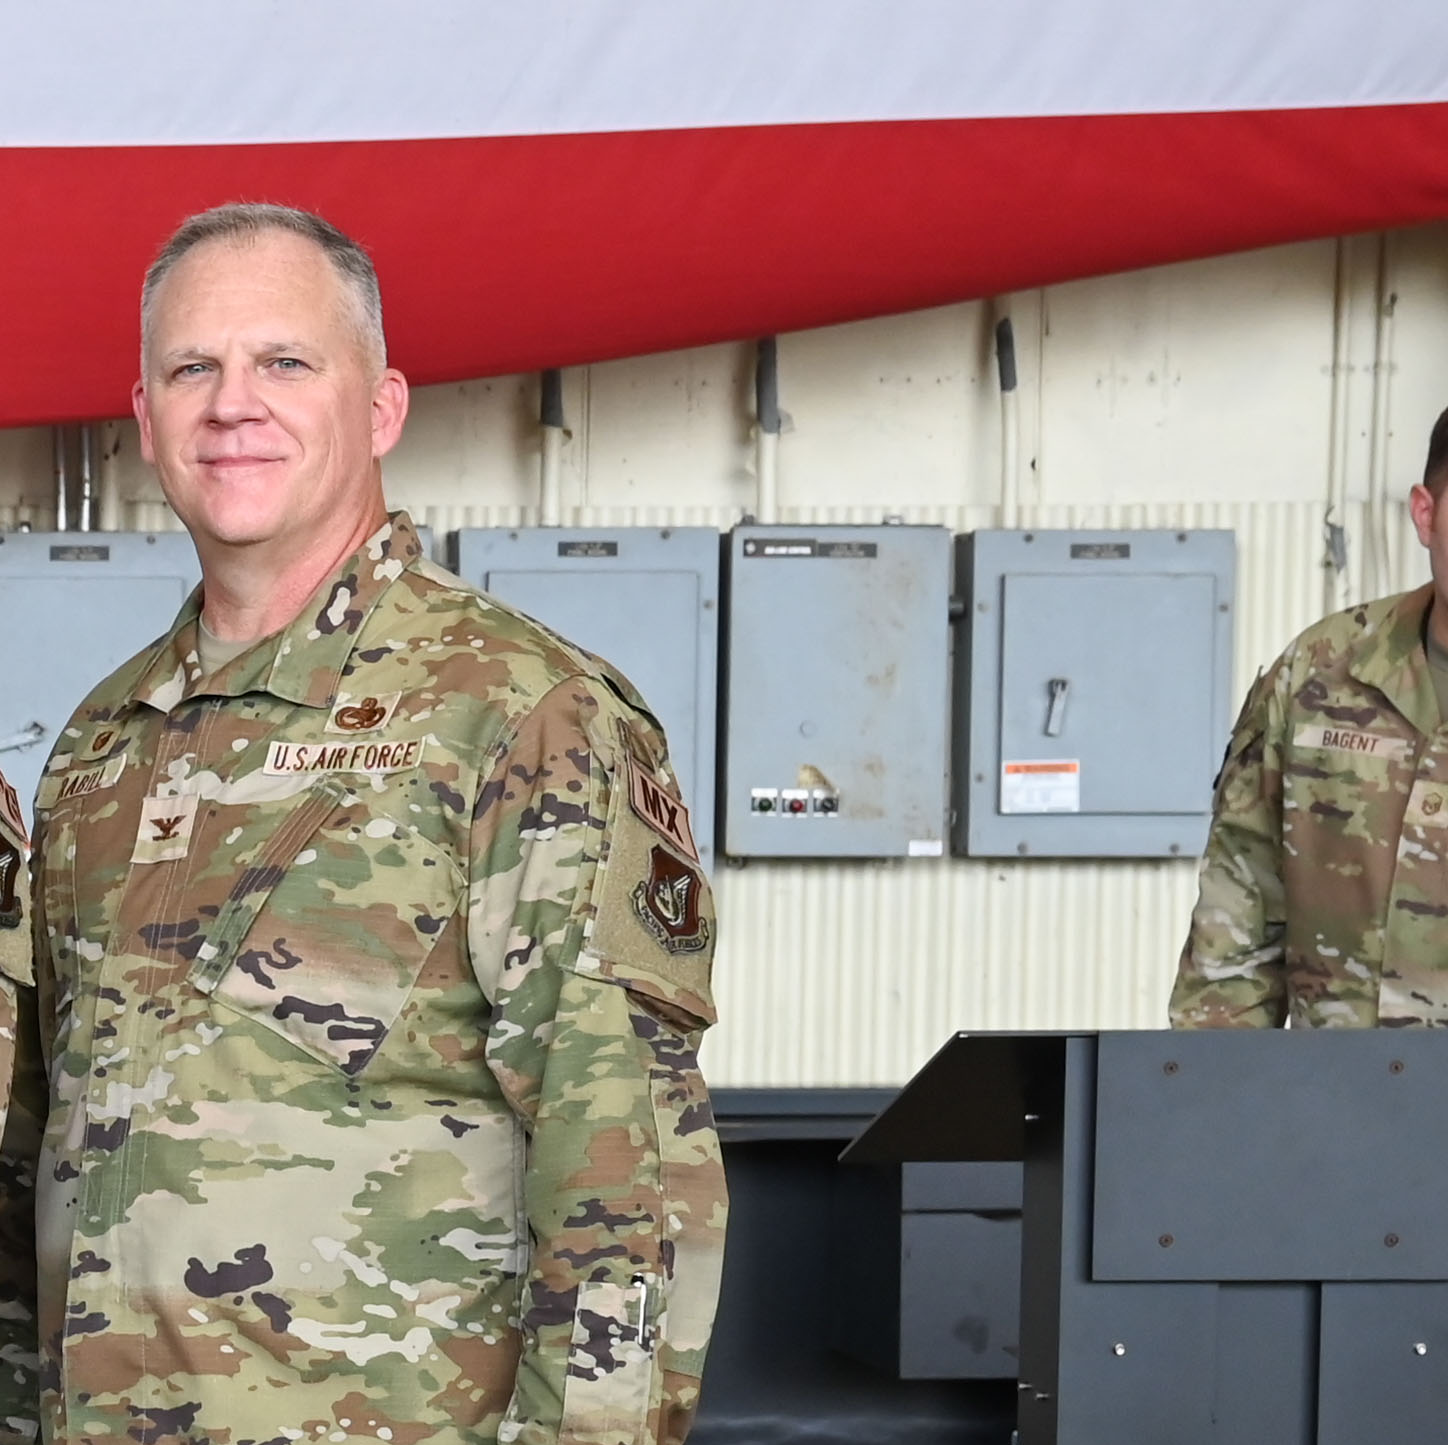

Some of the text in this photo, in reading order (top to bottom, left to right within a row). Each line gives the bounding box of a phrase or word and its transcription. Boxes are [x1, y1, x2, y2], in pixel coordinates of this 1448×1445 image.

[1322, 730, 1380, 753] BAGENT
[273, 742, 418, 771] U.S. AIR FORCE
[640, 774, 684, 844] MX
